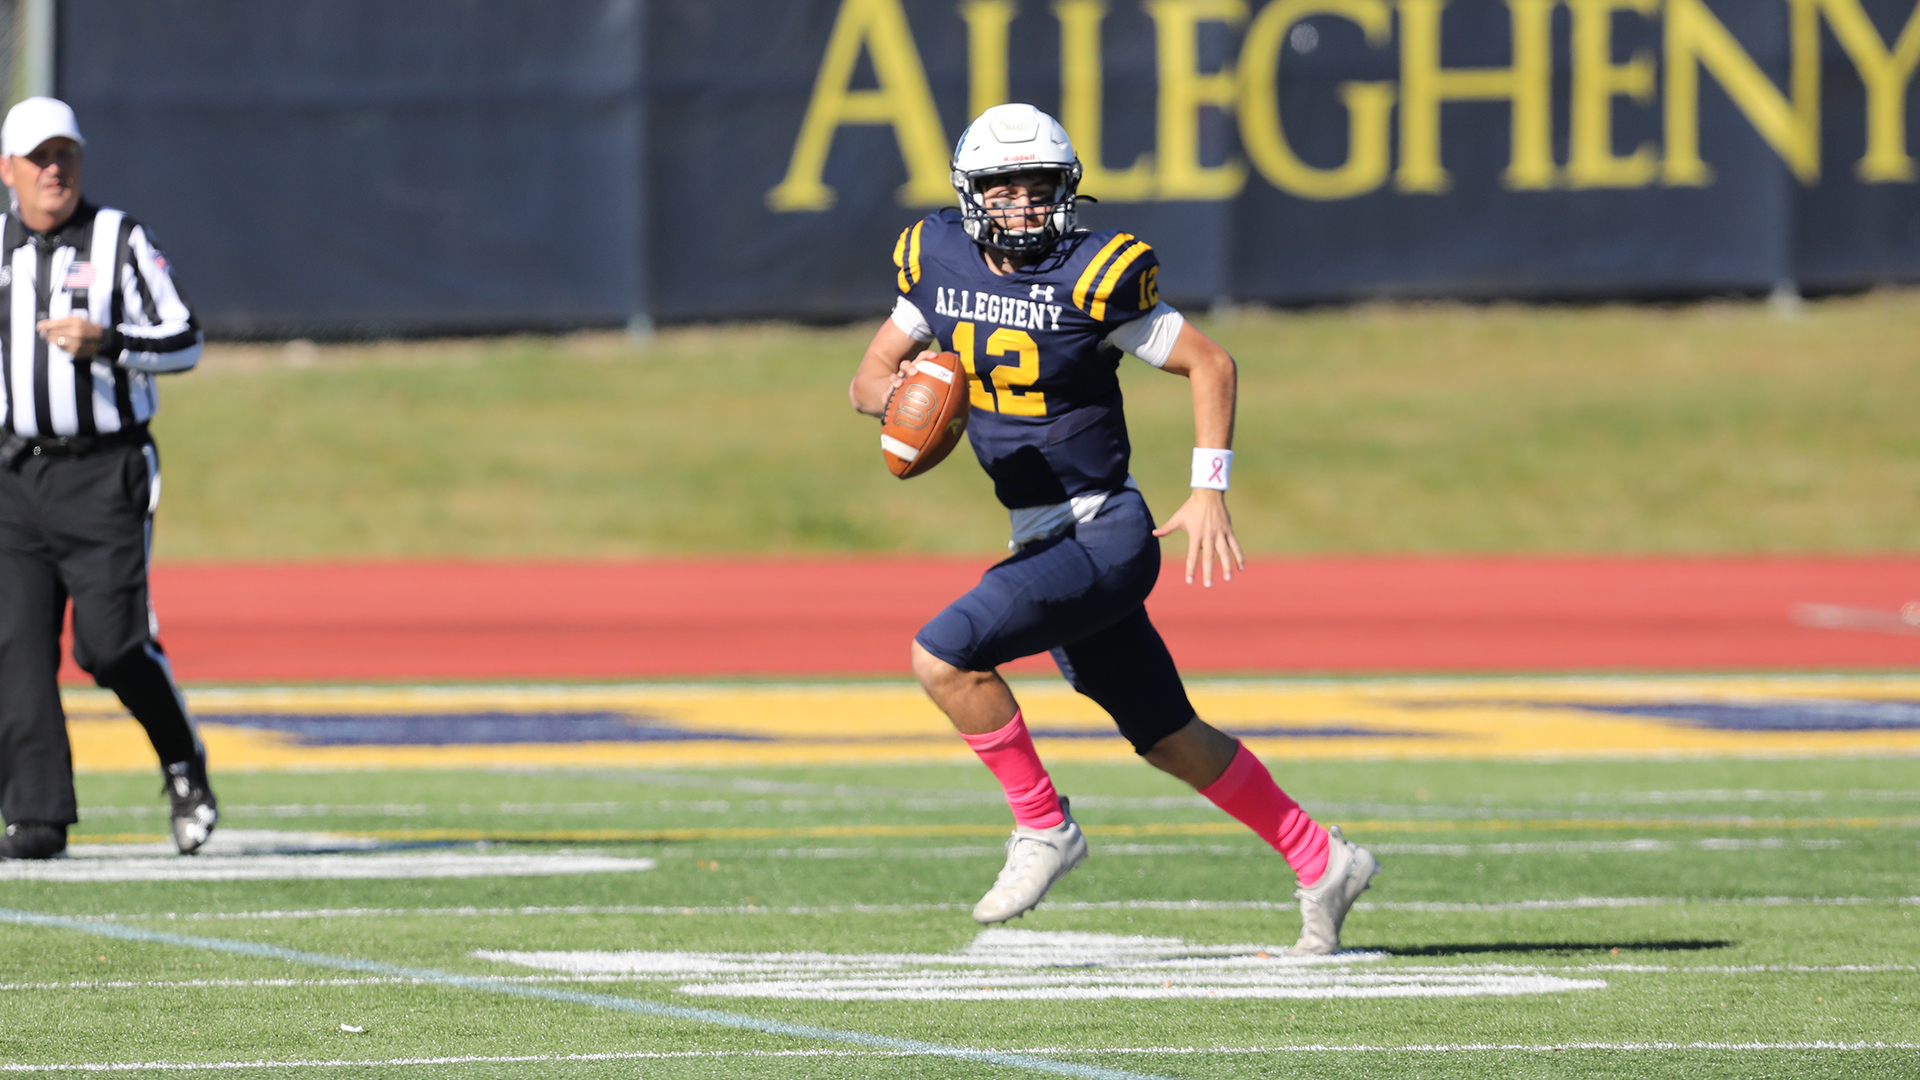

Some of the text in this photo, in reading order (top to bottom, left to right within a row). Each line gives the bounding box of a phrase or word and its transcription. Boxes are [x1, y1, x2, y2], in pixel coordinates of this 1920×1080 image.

[935, 286, 1063, 331] ALLEGHENY
[1138, 265, 1159, 310] 12
[952, 321, 1047, 417] 12
